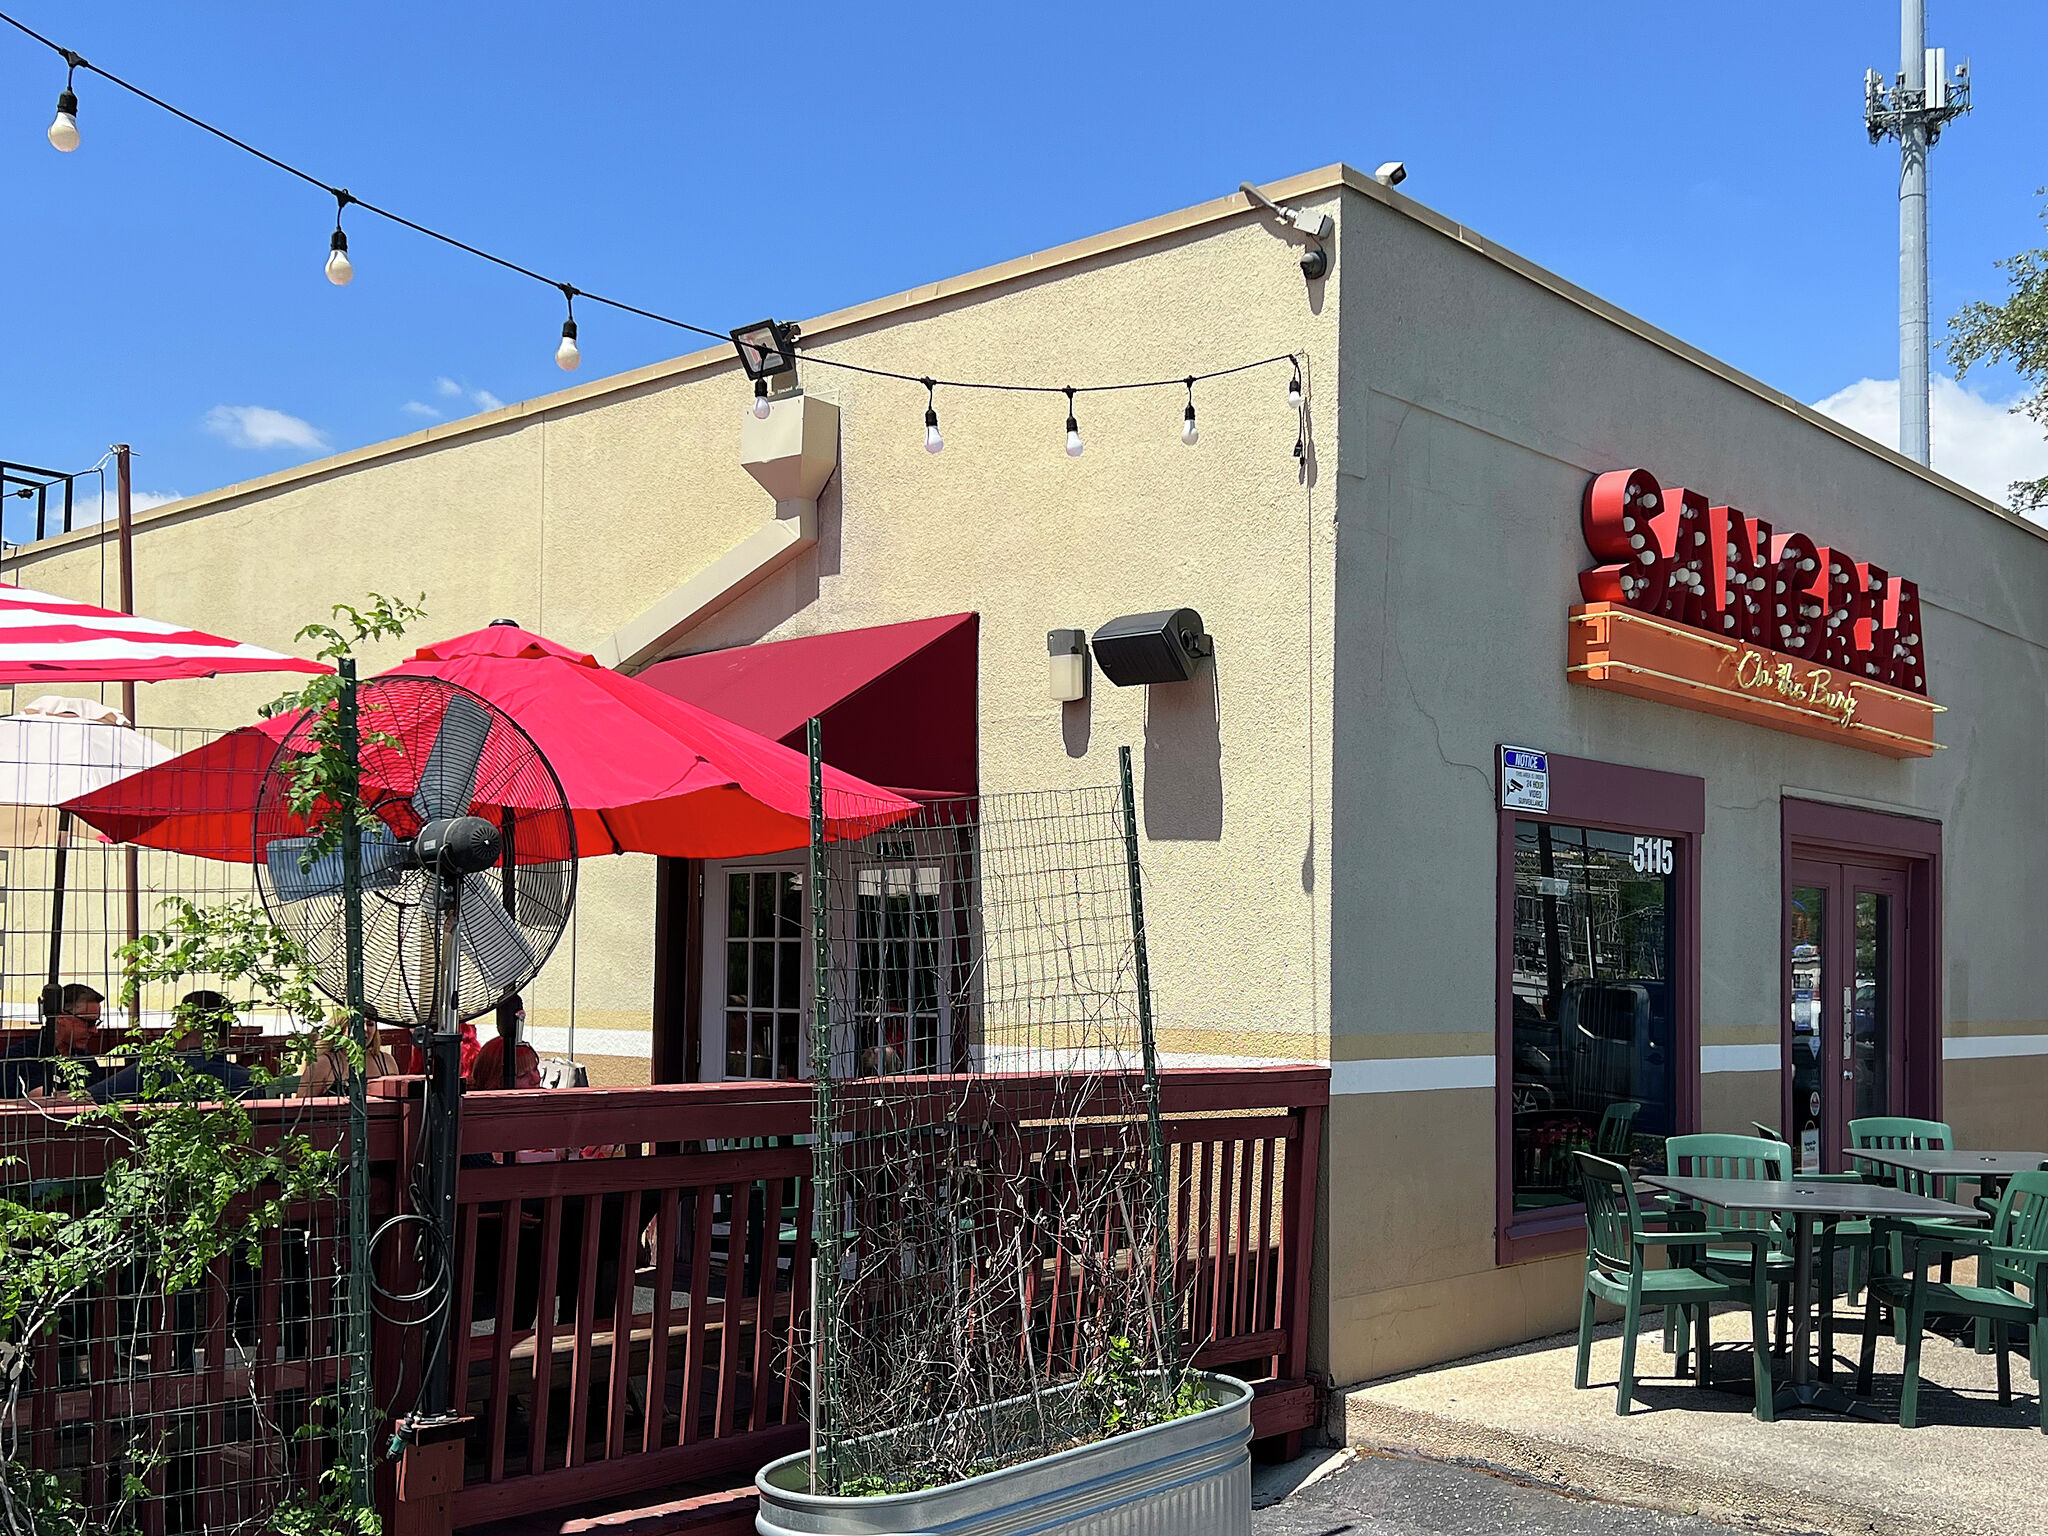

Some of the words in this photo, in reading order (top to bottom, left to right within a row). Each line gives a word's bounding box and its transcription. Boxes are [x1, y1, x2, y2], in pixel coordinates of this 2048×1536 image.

[1579, 467, 1927, 698] SANGRIA
[1737, 650, 1773, 689] On
[1775, 662, 1808, 701] the
[1806, 669, 1859, 729] Burg
[1515, 753, 1538, 768] NOTICE
[1633, 836, 1673, 875] 5115
